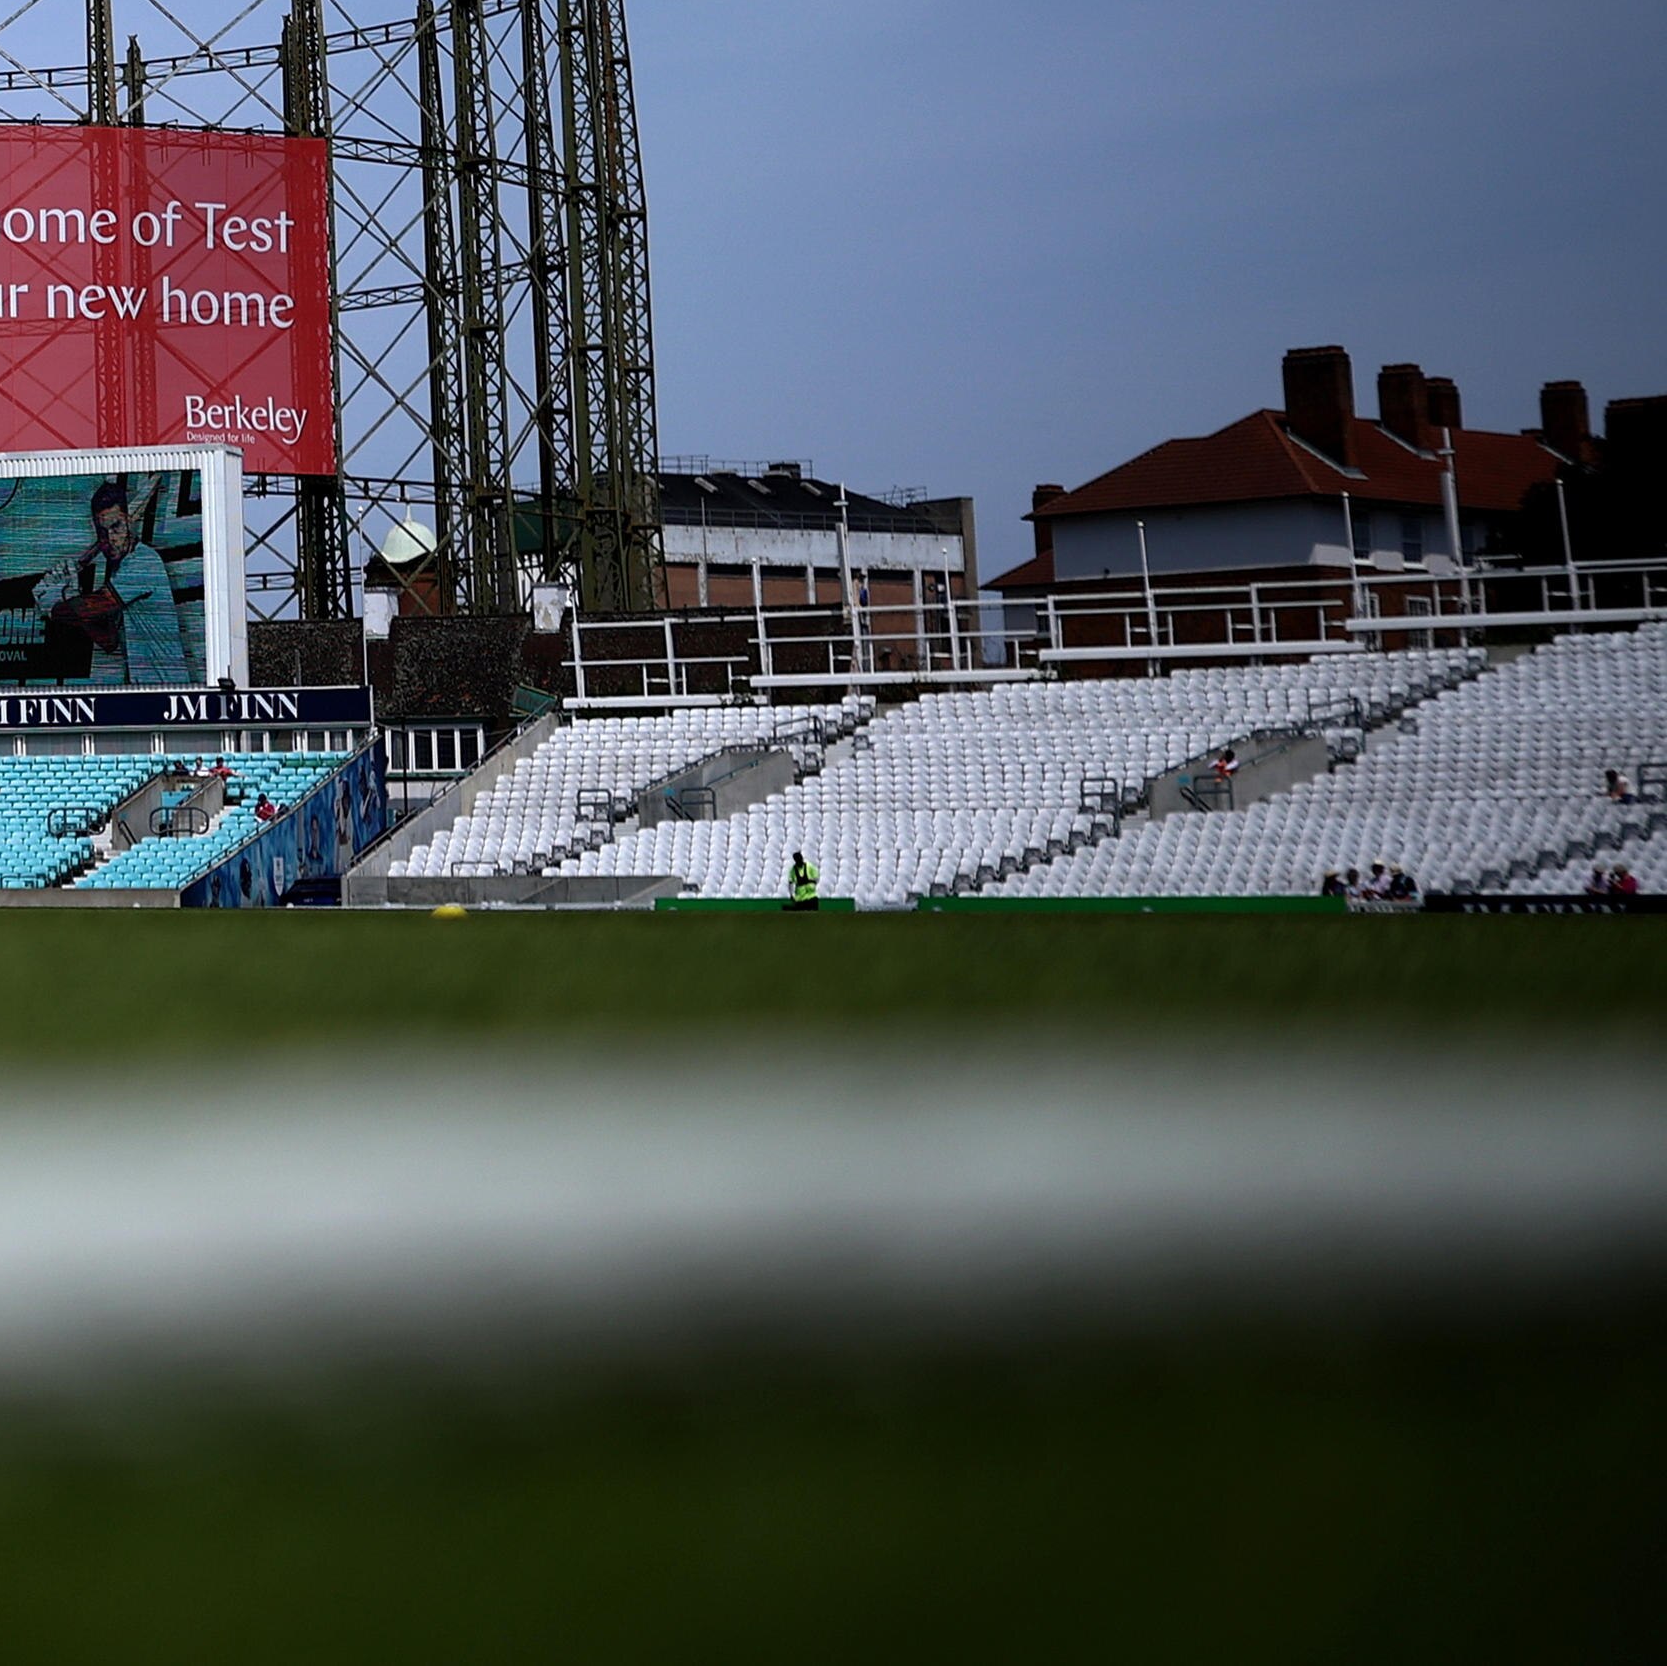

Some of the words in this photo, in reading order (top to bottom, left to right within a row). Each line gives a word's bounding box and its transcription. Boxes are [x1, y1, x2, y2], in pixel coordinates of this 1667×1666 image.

[132, 200, 182, 247] of
[194, 202, 294, 253] Test
[47, 283, 147, 320] new
[162, 276, 294, 329] home
[185, 394, 307, 445] Berkeley
[187, 431, 225, 444] Designed
[227, 432, 240, 443] for
[241, 433, 256, 444] life
[19, 697, 96, 724] FINN
[163, 694, 208, 721] JM
[218, 692, 299, 720] FINN
